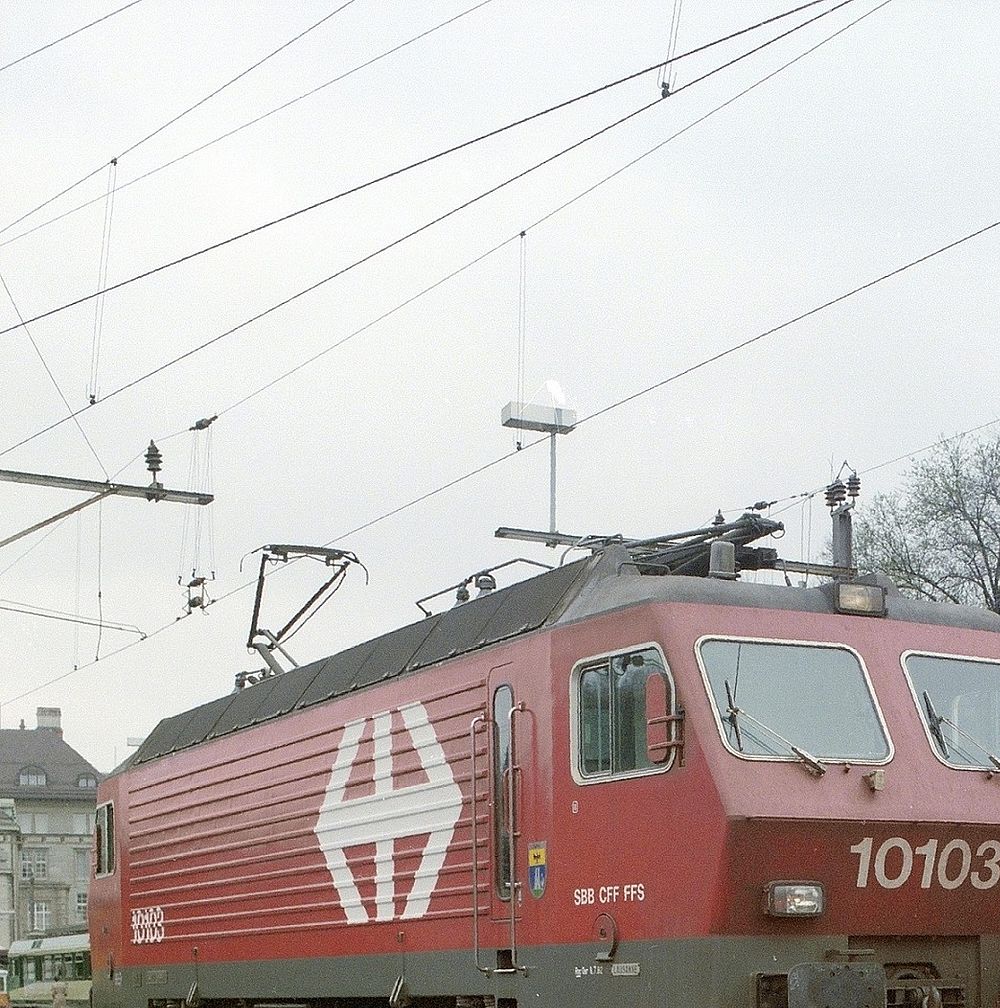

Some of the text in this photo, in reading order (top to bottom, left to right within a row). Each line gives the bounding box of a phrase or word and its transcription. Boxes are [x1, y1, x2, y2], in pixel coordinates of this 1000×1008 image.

[574, 883, 645, 905] SBB CFF FFS
[132, 906, 165, 944] 10103
